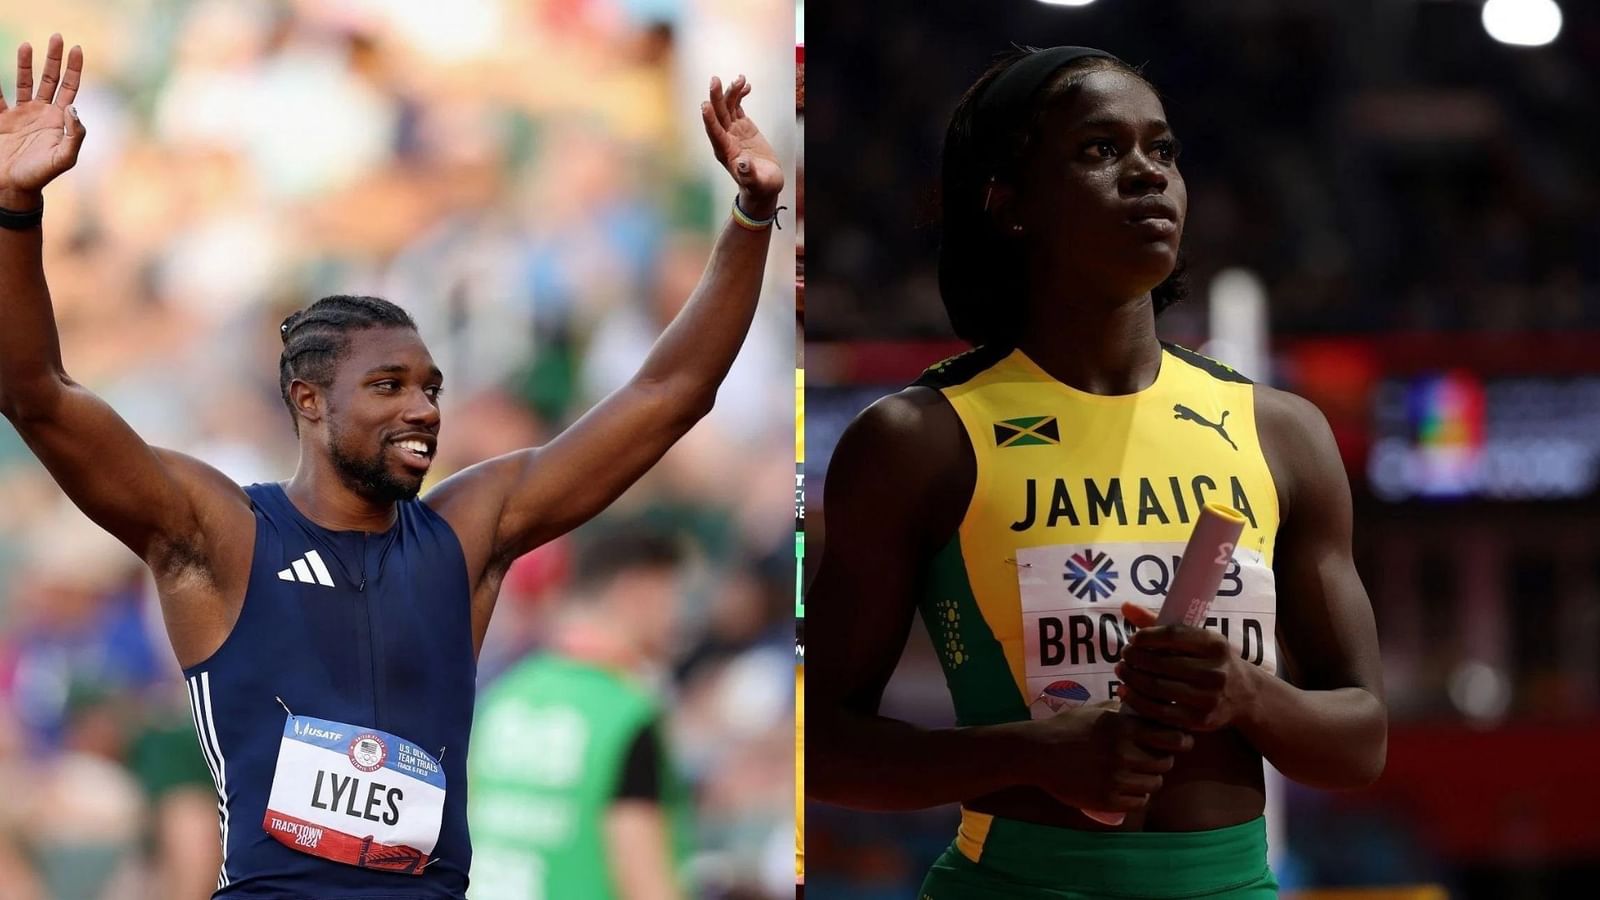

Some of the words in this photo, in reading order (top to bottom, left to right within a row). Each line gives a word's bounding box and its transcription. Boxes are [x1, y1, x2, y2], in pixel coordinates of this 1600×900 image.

[309, 727, 343, 741] USATF
[399, 743, 412, 754] U.S.
[398, 752, 416, 766] TEAM
[416, 758, 438, 773] TRIALS
[310, 770, 404, 826] LYLES
[271, 817, 323, 840] TRACKTOWN
[295, 833, 318, 849] 2024
